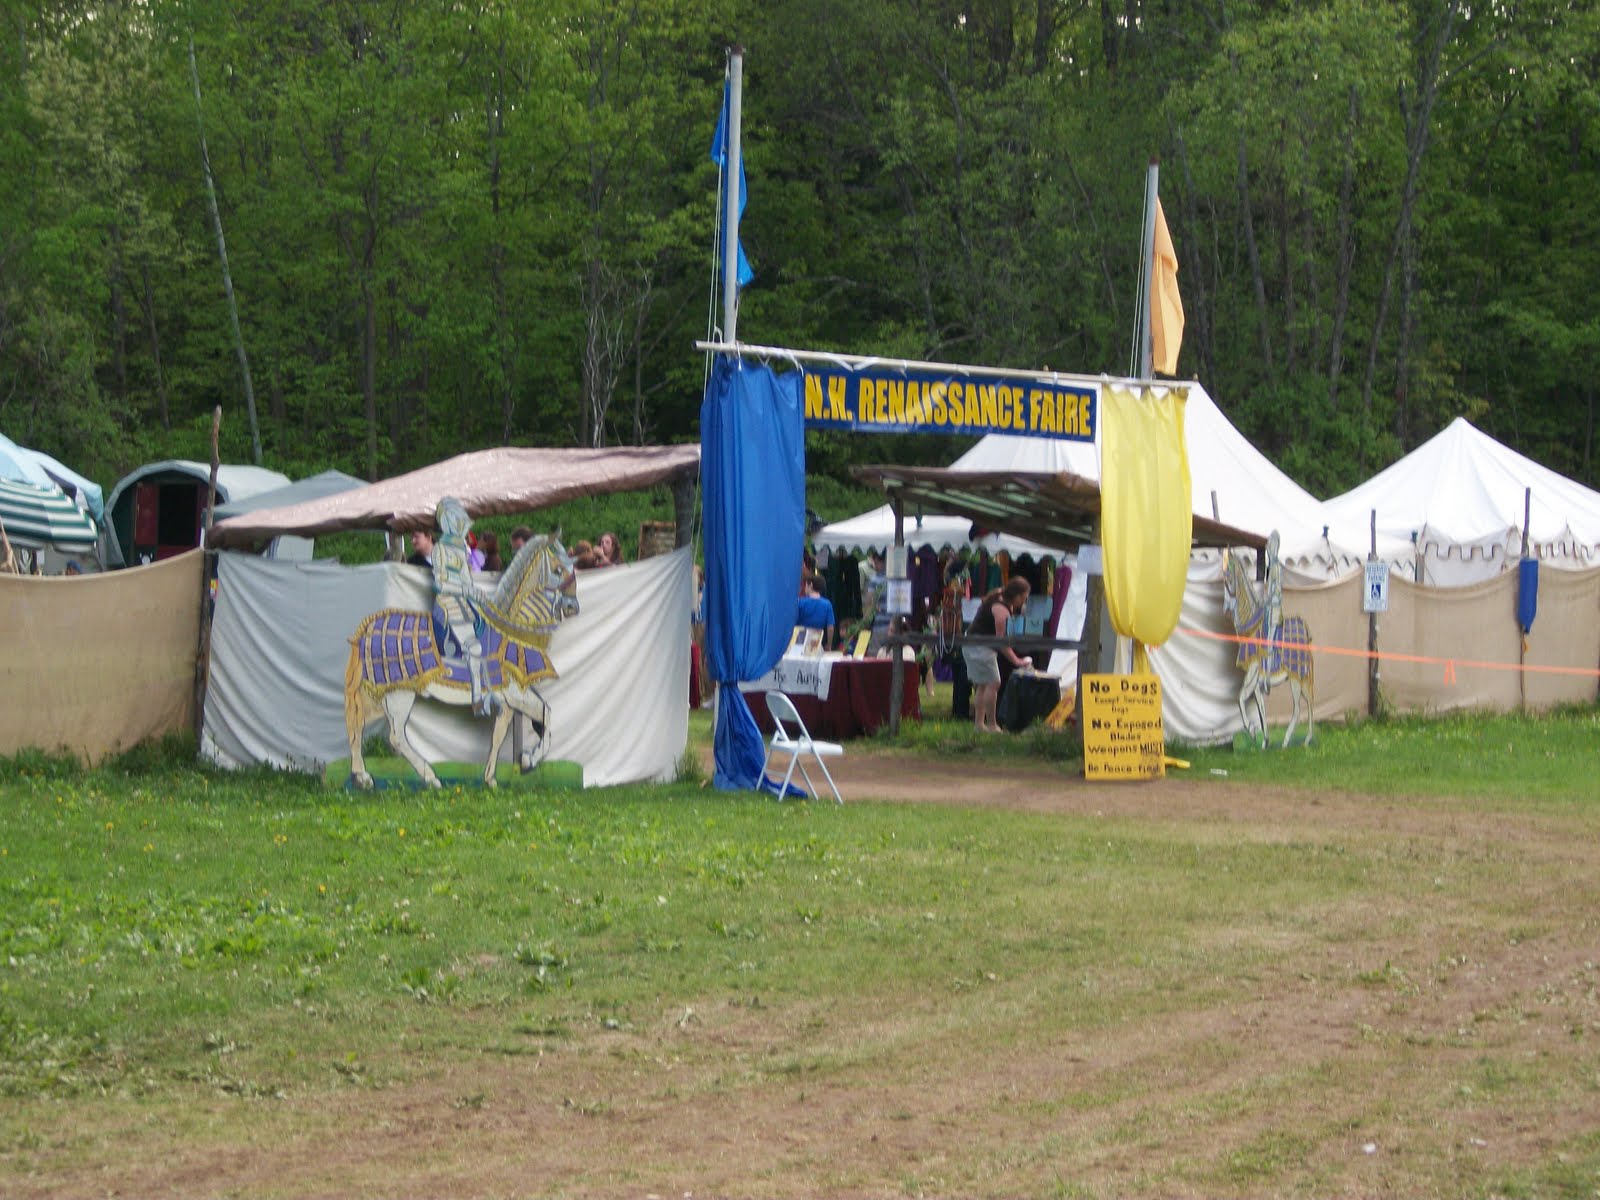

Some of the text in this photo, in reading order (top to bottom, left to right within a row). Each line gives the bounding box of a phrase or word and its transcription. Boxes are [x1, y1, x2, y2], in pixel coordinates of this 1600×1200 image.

[804, 374, 1092, 437] N.H. RENAISSANCE FAIRE
[1090, 680, 1157, 696] No Dogs
[1091, 717, 1162, 732] No Exposed
[1110, 732, 1141, 741] Blades
[1087, 742, 1163, 757] Weapons MUST
